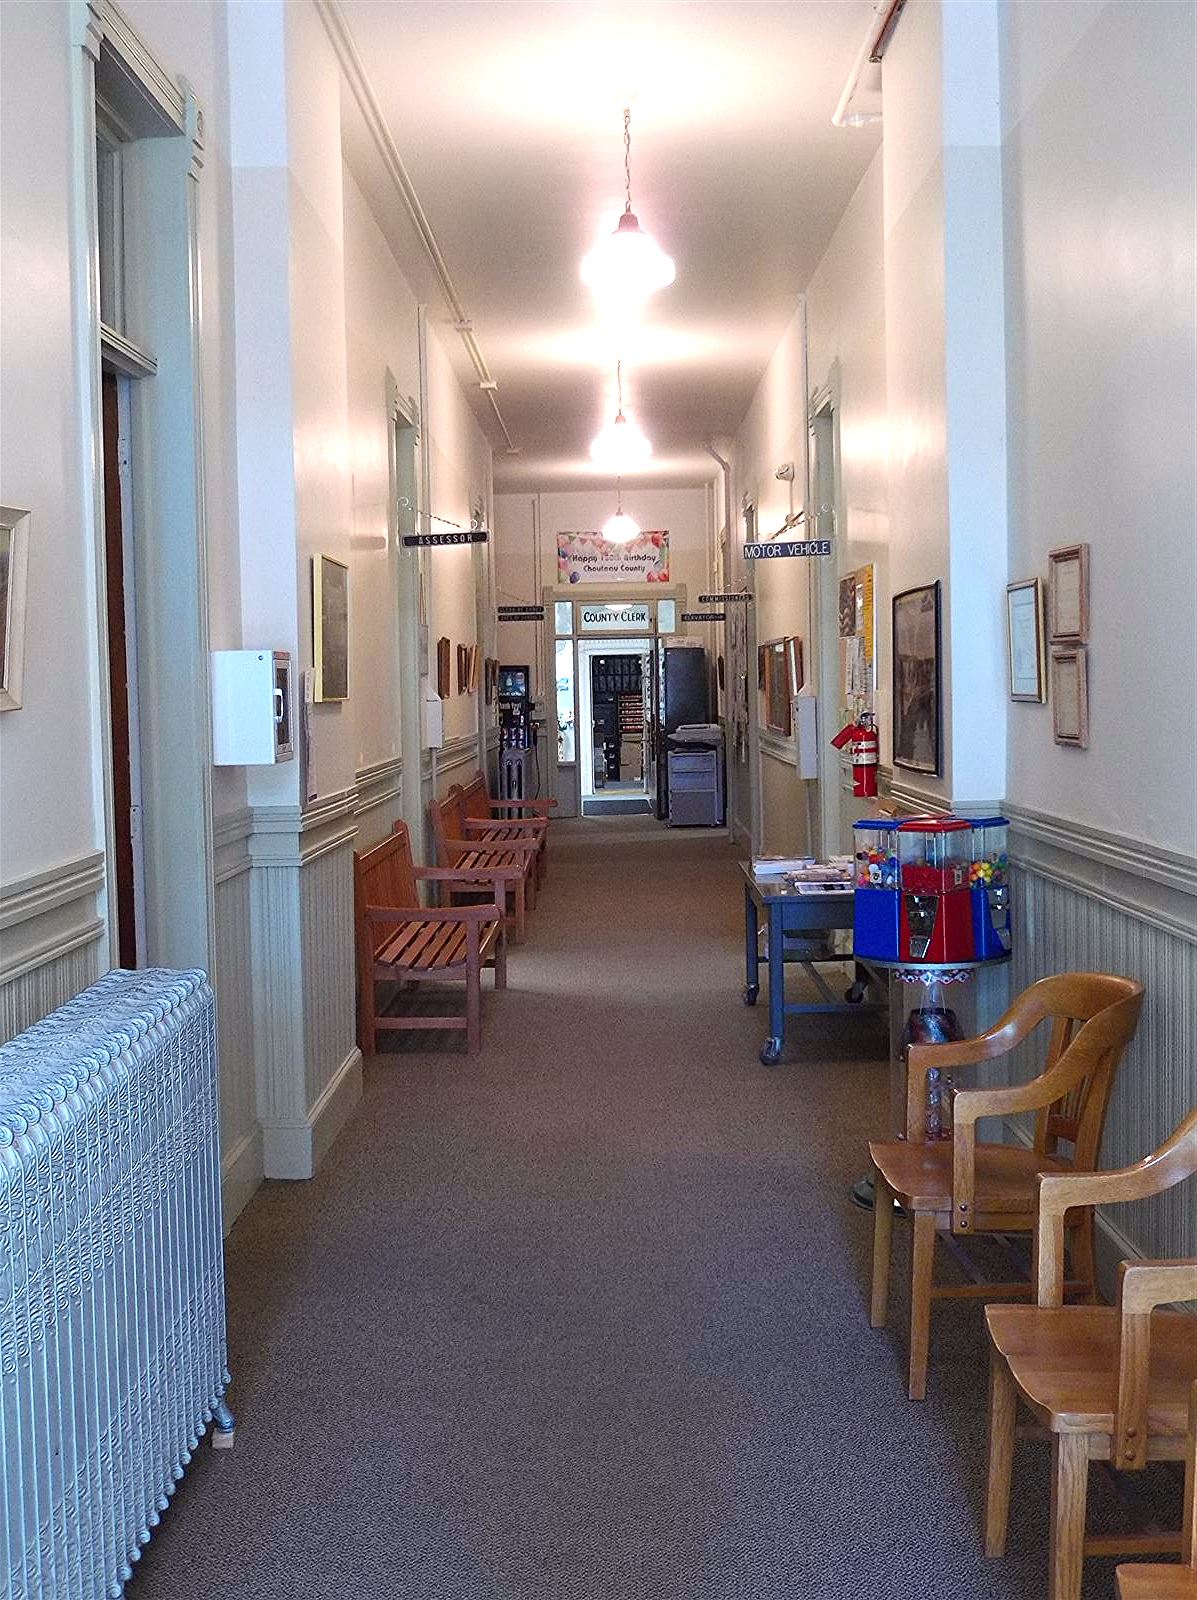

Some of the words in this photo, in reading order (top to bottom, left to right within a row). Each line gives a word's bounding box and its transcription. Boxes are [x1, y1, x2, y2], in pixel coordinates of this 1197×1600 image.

[418, 534, 473, 545] ASSESSOR
[744, 544, 781, 558] MOTOR
[787, 540, 829, 555] VEHICLE
[572, 554, 598, 563] Happy
[624, 553, 656, 562] Birthday
[620, 564, 646, 573] County
[584, 612, 619, 622] COUNTY
[621, 612, 646, 622] CLERK
